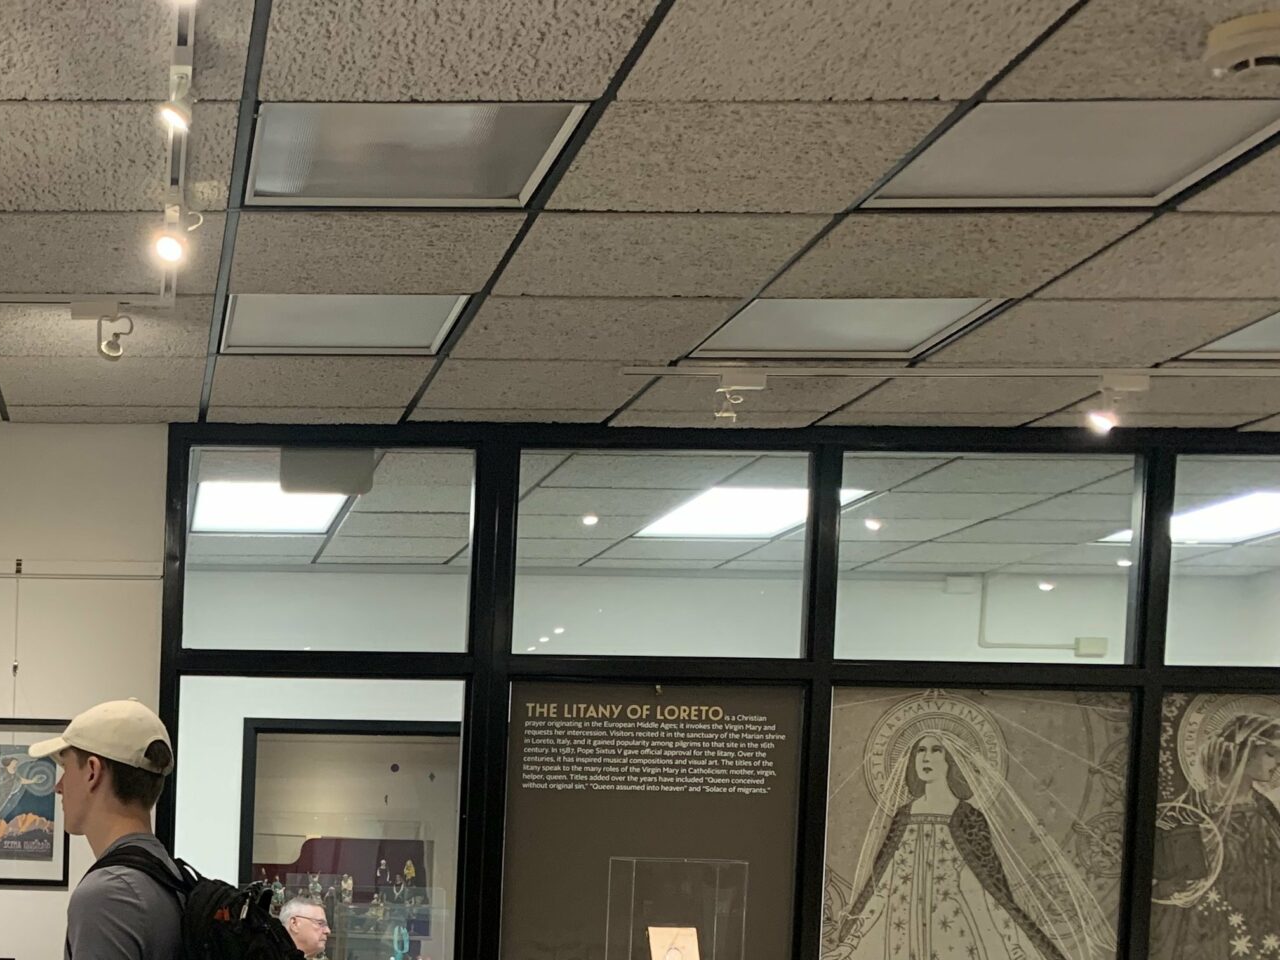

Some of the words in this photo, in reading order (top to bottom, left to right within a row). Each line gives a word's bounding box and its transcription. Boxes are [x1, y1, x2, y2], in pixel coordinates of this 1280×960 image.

[526, 704, 557, 718] THE
[564, 704, 623, 718] LITANY
[626, 705, 650, 719] OF
[656, 706, 723, 720] LORETO
[737, 714, 767, 722] Christian
[525, 720, 545, 728] prayer
[547, 719, 582, 729] originating
[604, 720, 635, 730] European
[724, 723, 744, 732] Virgin
[745, 723, 762, 732] Mary
[524, 727, 553, 737] requests
[686, 731, 719, 740] sanctuary
[765, 732, 786, 740] shrine
[593, 738, 615, 747] gained
[616, 739, 649, 748] popularity
[651, 741, 673, 749] among
[675, 740, 701, 749] pilgrims
[577, 746, 594, 756] Pope
[623, 749, 639, 757] gave
[663, 748, 692, 758] approval
[872, 722, 895, 781] STELLA
[576, 756, 602, 765] inspired
[629, 757, 673, 766] compositions
[523, 763, 541, 773] litany
[542, 764, 561, 773] speak
[584, 766, 602, 774] many
[642, 766, 661, 775] Virgin
[662, 766, 679, 776] Mary
[639, 776, 658, 784] years
[549, 782, 574, 791] original
